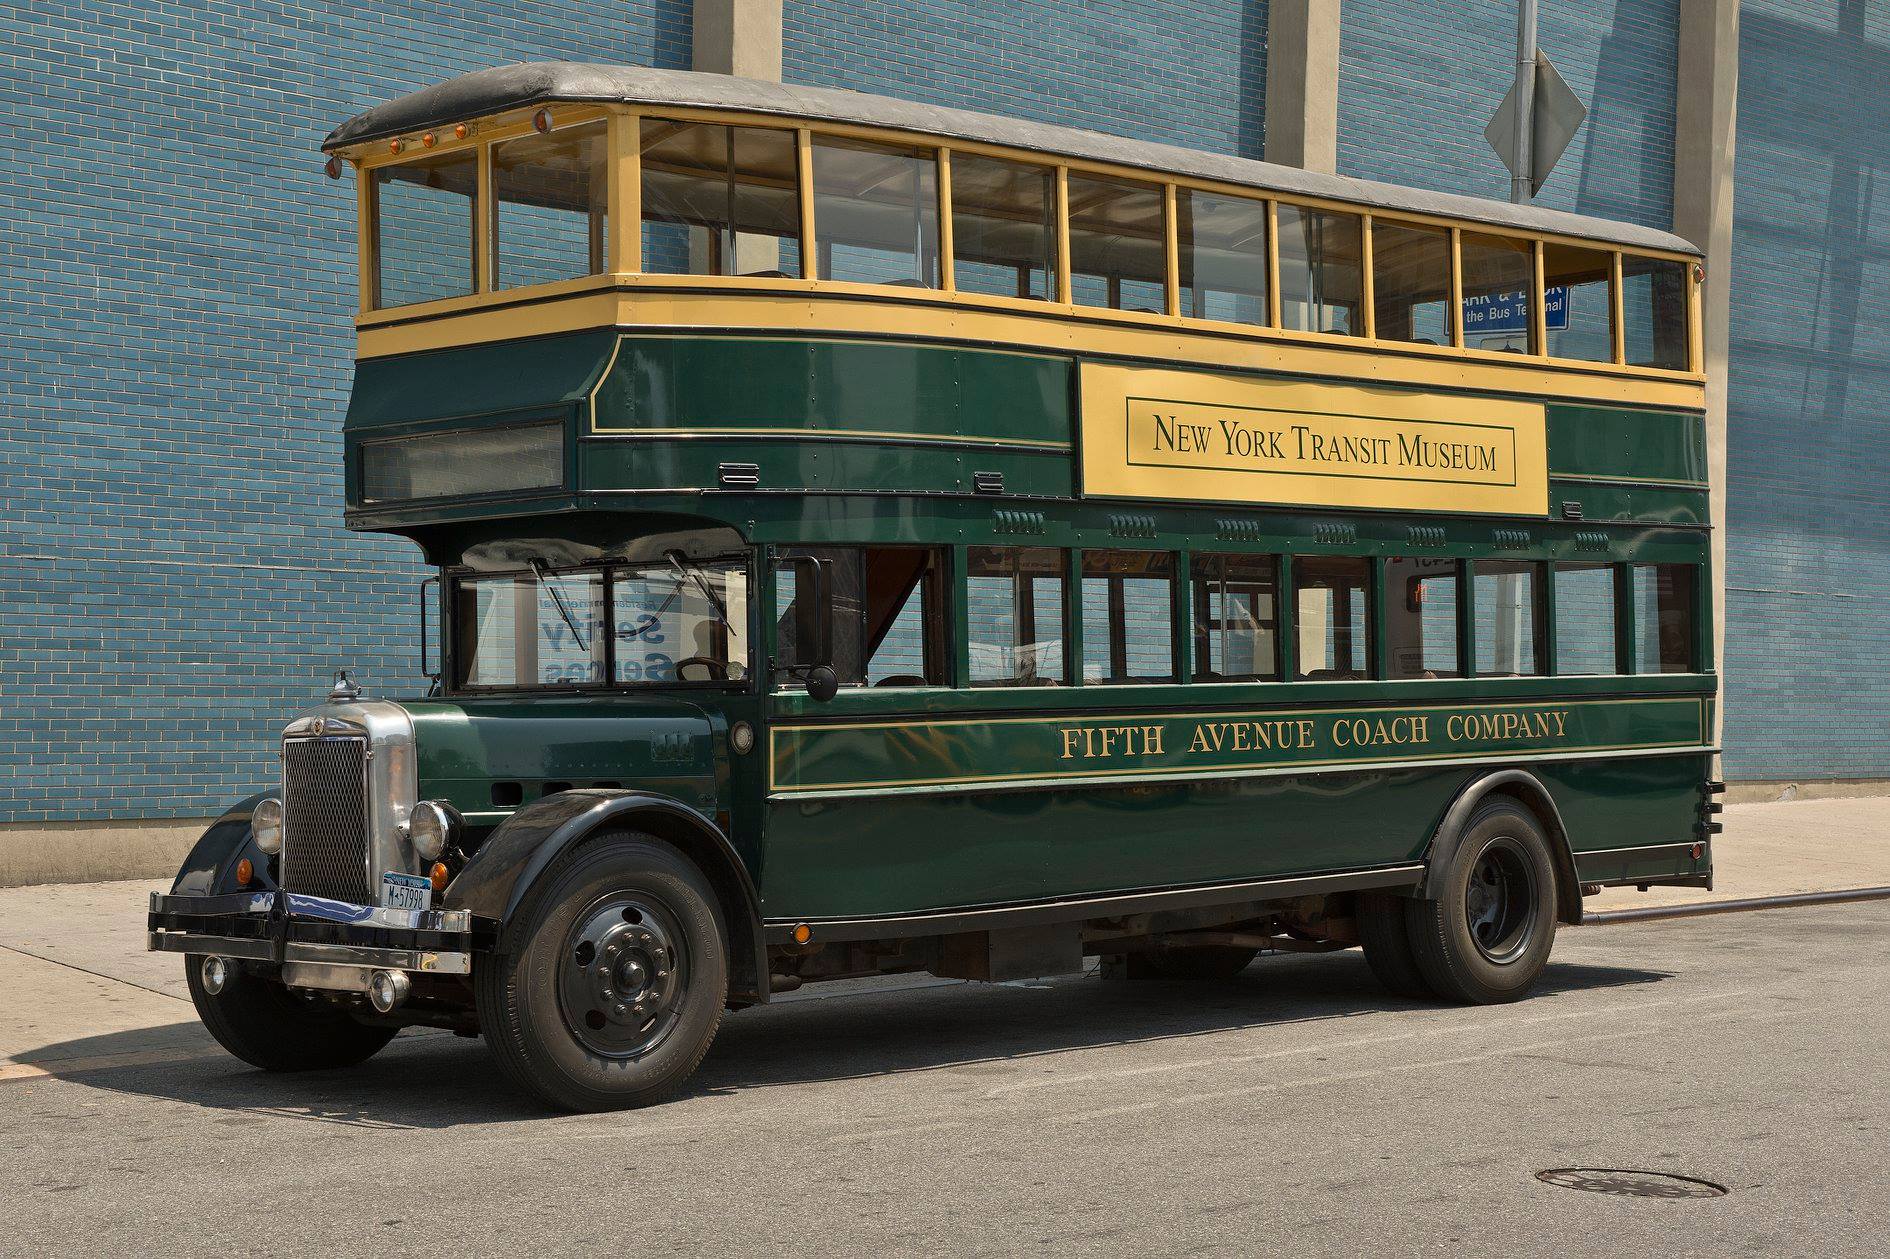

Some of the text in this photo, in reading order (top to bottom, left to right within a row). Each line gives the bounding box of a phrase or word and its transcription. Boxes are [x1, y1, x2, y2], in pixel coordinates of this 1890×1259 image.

[1466, 298, 1562, 323] the Bus Tenal
[1152, 414, 1497, 472] NEW YORK TRANSIT MUSEUM
[1060, 711, 1568, 759] FIFTH AVENUE COACH COMPANY
